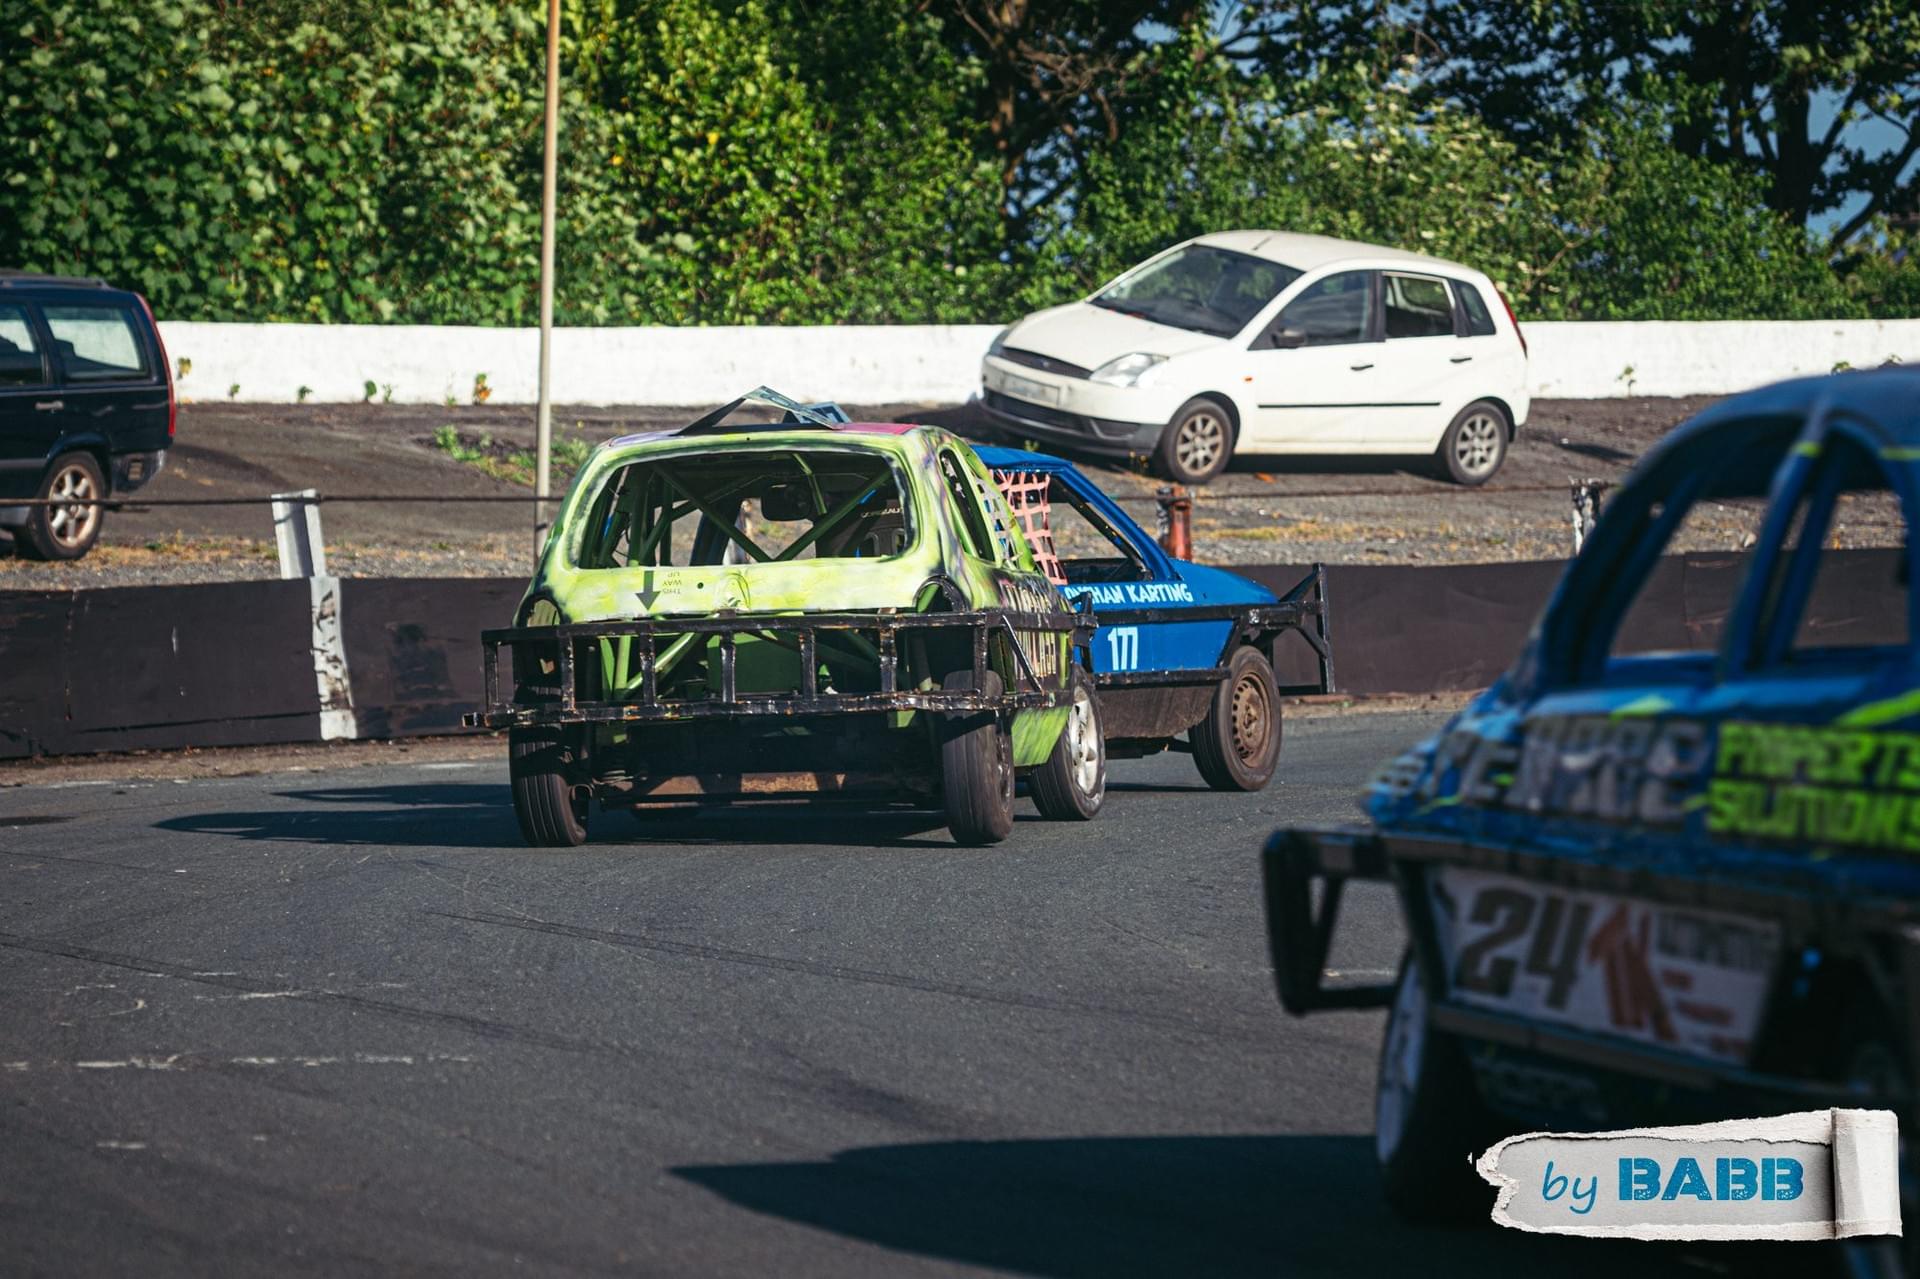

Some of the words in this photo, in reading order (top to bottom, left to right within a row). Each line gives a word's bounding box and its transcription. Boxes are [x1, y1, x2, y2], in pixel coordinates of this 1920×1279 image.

[1126, 583, 1194, 603] KARTING
[1107, 626, 1139, 671] 177
[1453, 886, 1595, 1011] 24
